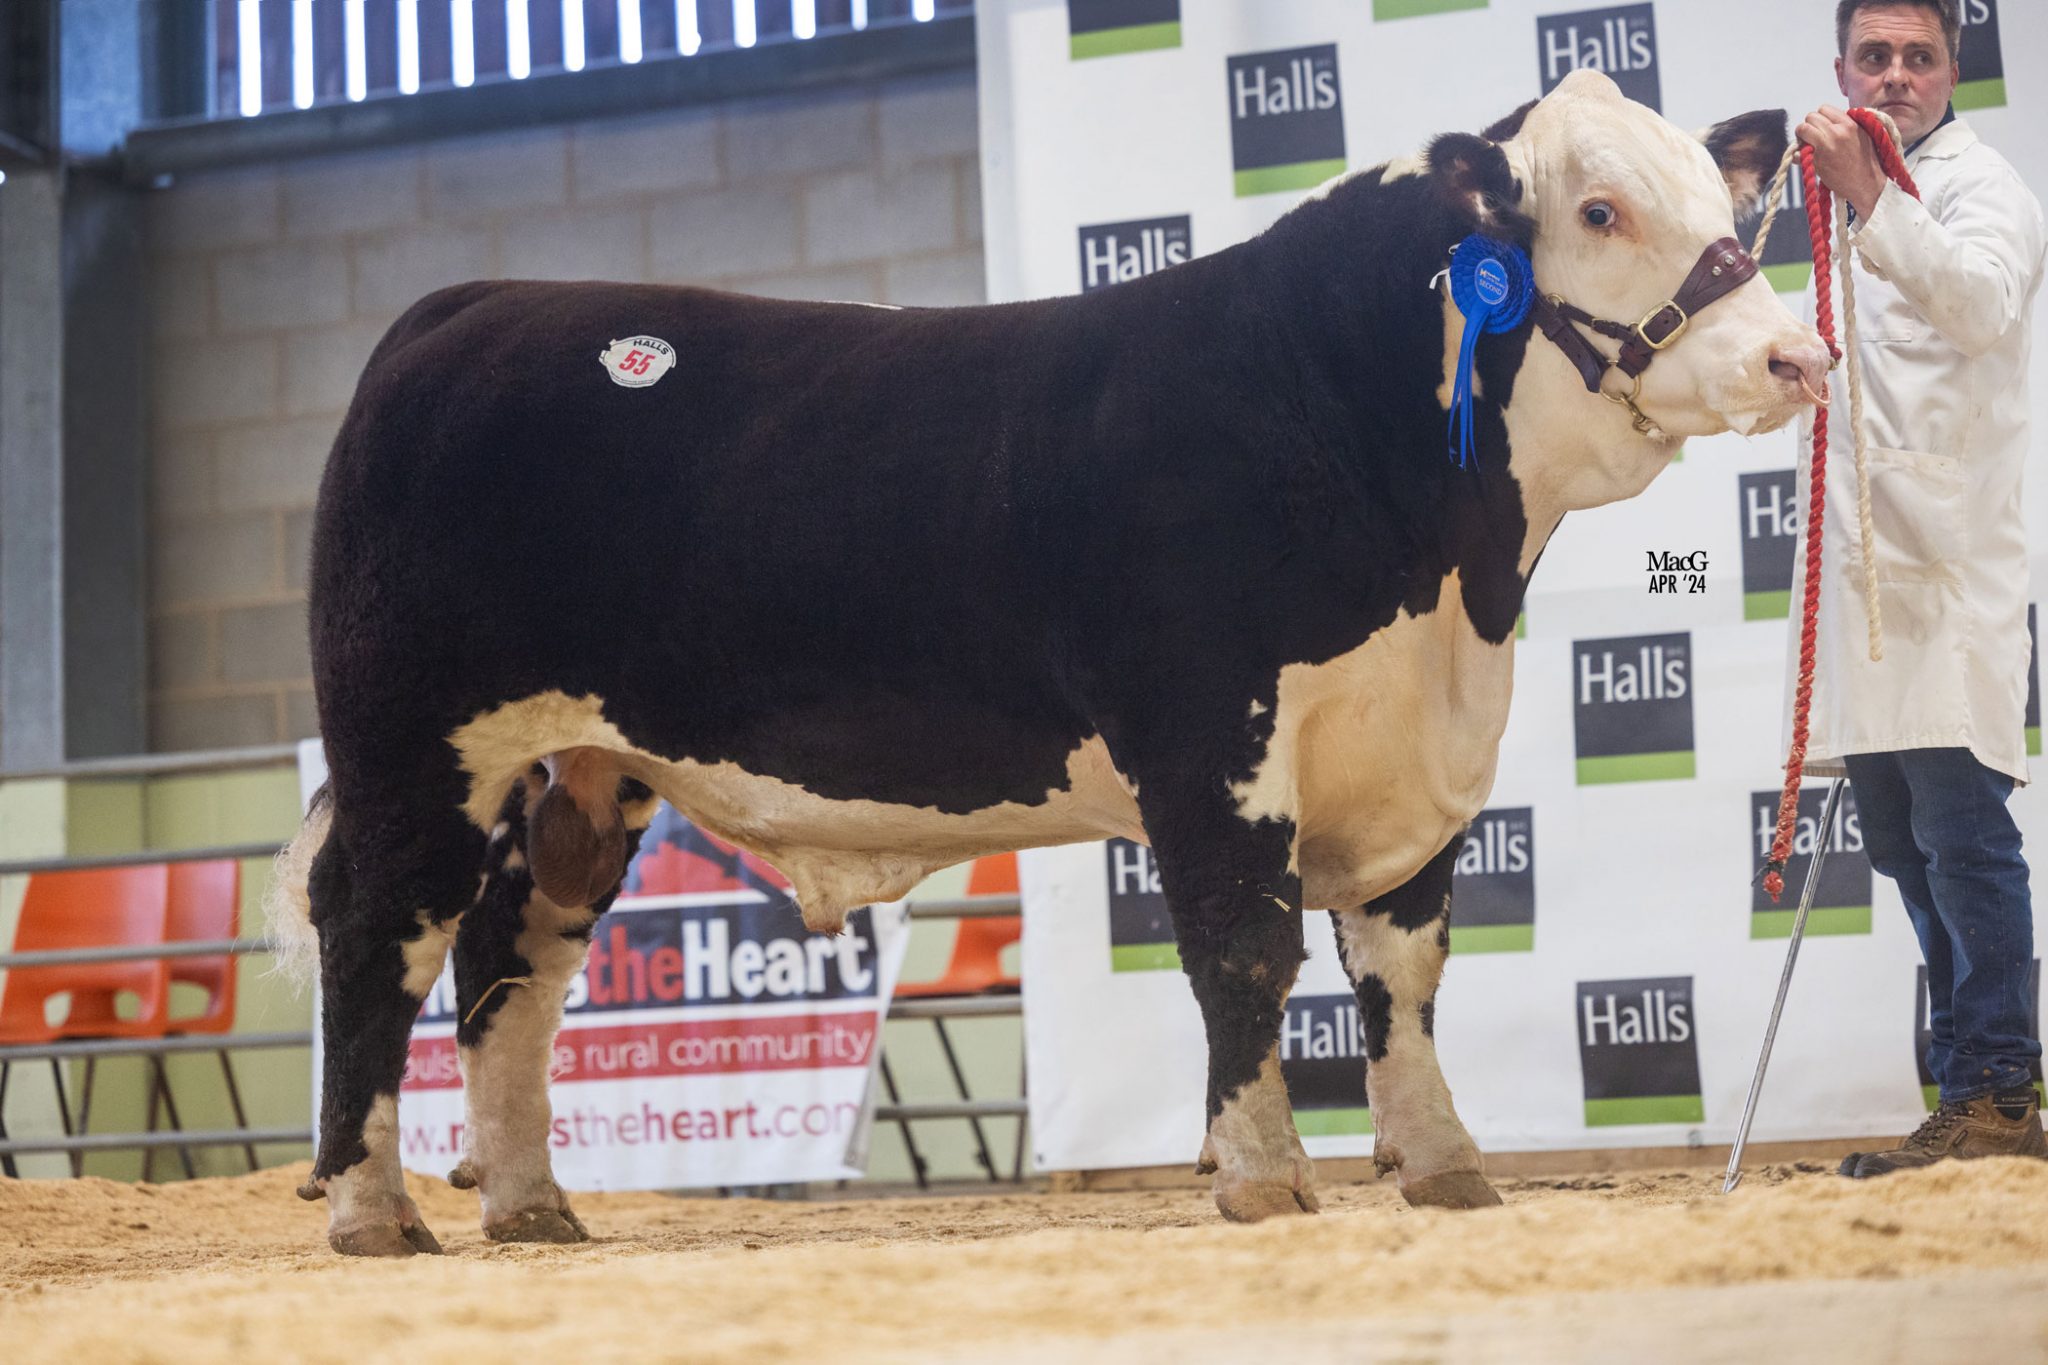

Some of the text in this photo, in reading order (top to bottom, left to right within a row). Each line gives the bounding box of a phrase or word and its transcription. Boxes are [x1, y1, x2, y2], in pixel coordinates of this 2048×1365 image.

[1545, 17, 1652, 79] Halls
[1235, 58, 1337, 118] Halls
[619, 349, 656, 375] 55
[633, 340, 669, 355] HALLS
[1580, 645, 1687, 704] Halls
[1453, 820, 1529, 876] alls
[1584, 989, 1690, 1046] Halls
[584, 1034, 660, 1075] rural
[667, 1022, 872, 1066] community
